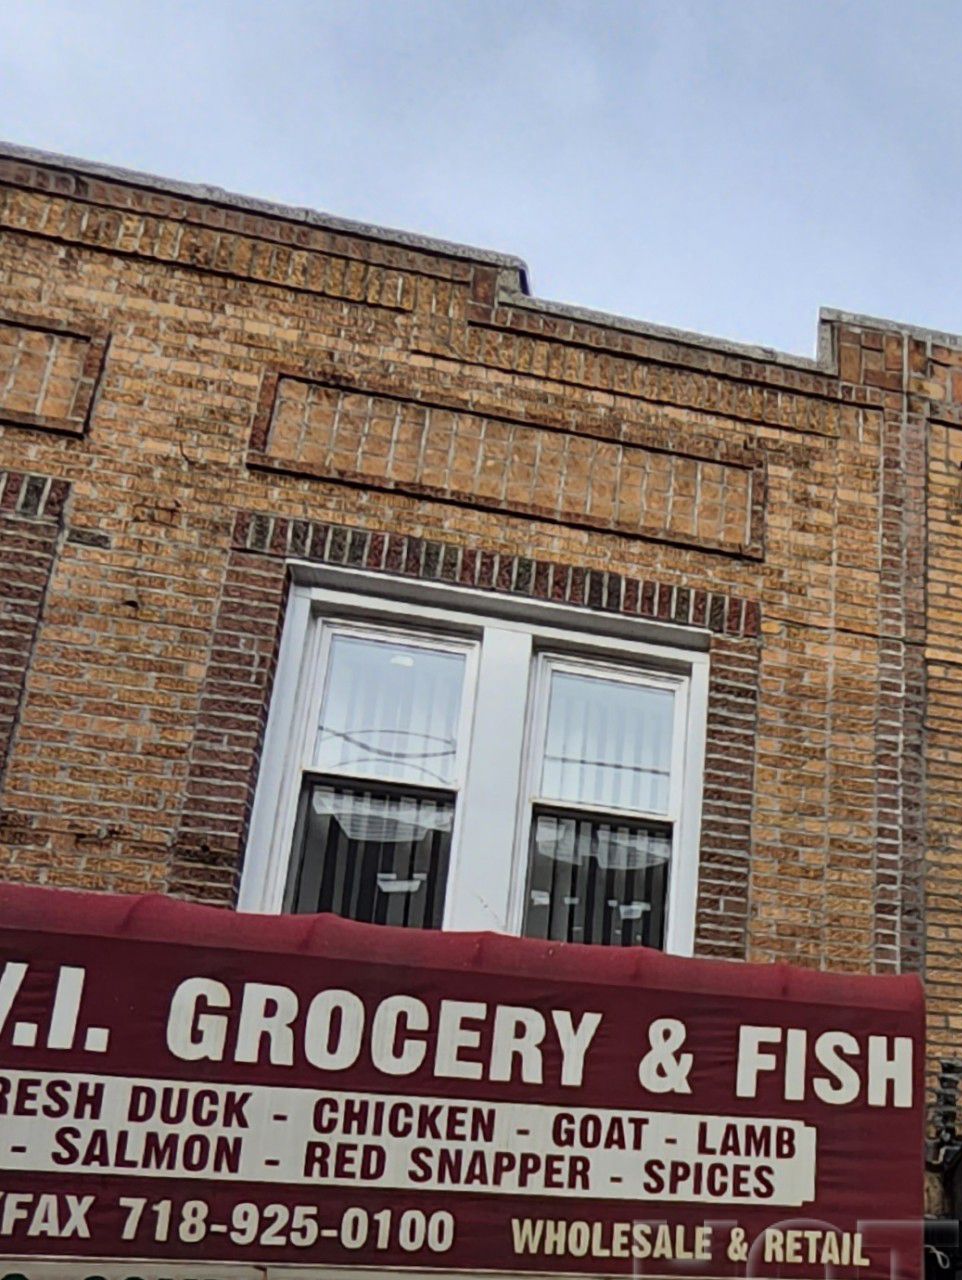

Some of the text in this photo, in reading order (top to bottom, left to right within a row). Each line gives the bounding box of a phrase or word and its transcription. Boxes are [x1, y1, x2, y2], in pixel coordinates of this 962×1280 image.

[166, 976, 603, 1087] GROCERY
[638, 1018, 694, 1094] &
[736, 1025, 914, 1108] FISH
[128, 1084, 252, 1128] DUCK
[313, 1098, 496, 1142] CHICKEN
[552, 1113, 649, 1150] GOAT
[698, 1122, 797, 1159] LAMB
[51, 1126, 243, 1173] SALMON
[304, 1141, 387, 1180] RED
[408, 1146, 591, 1191] SNAPPER
[643, 1159, 776, 1198] SPICES
[0, 1192, 454, 1252] FAX 718-925-0100
[511, 1218, 870, 1267] WHOLESALE & RETAIL
